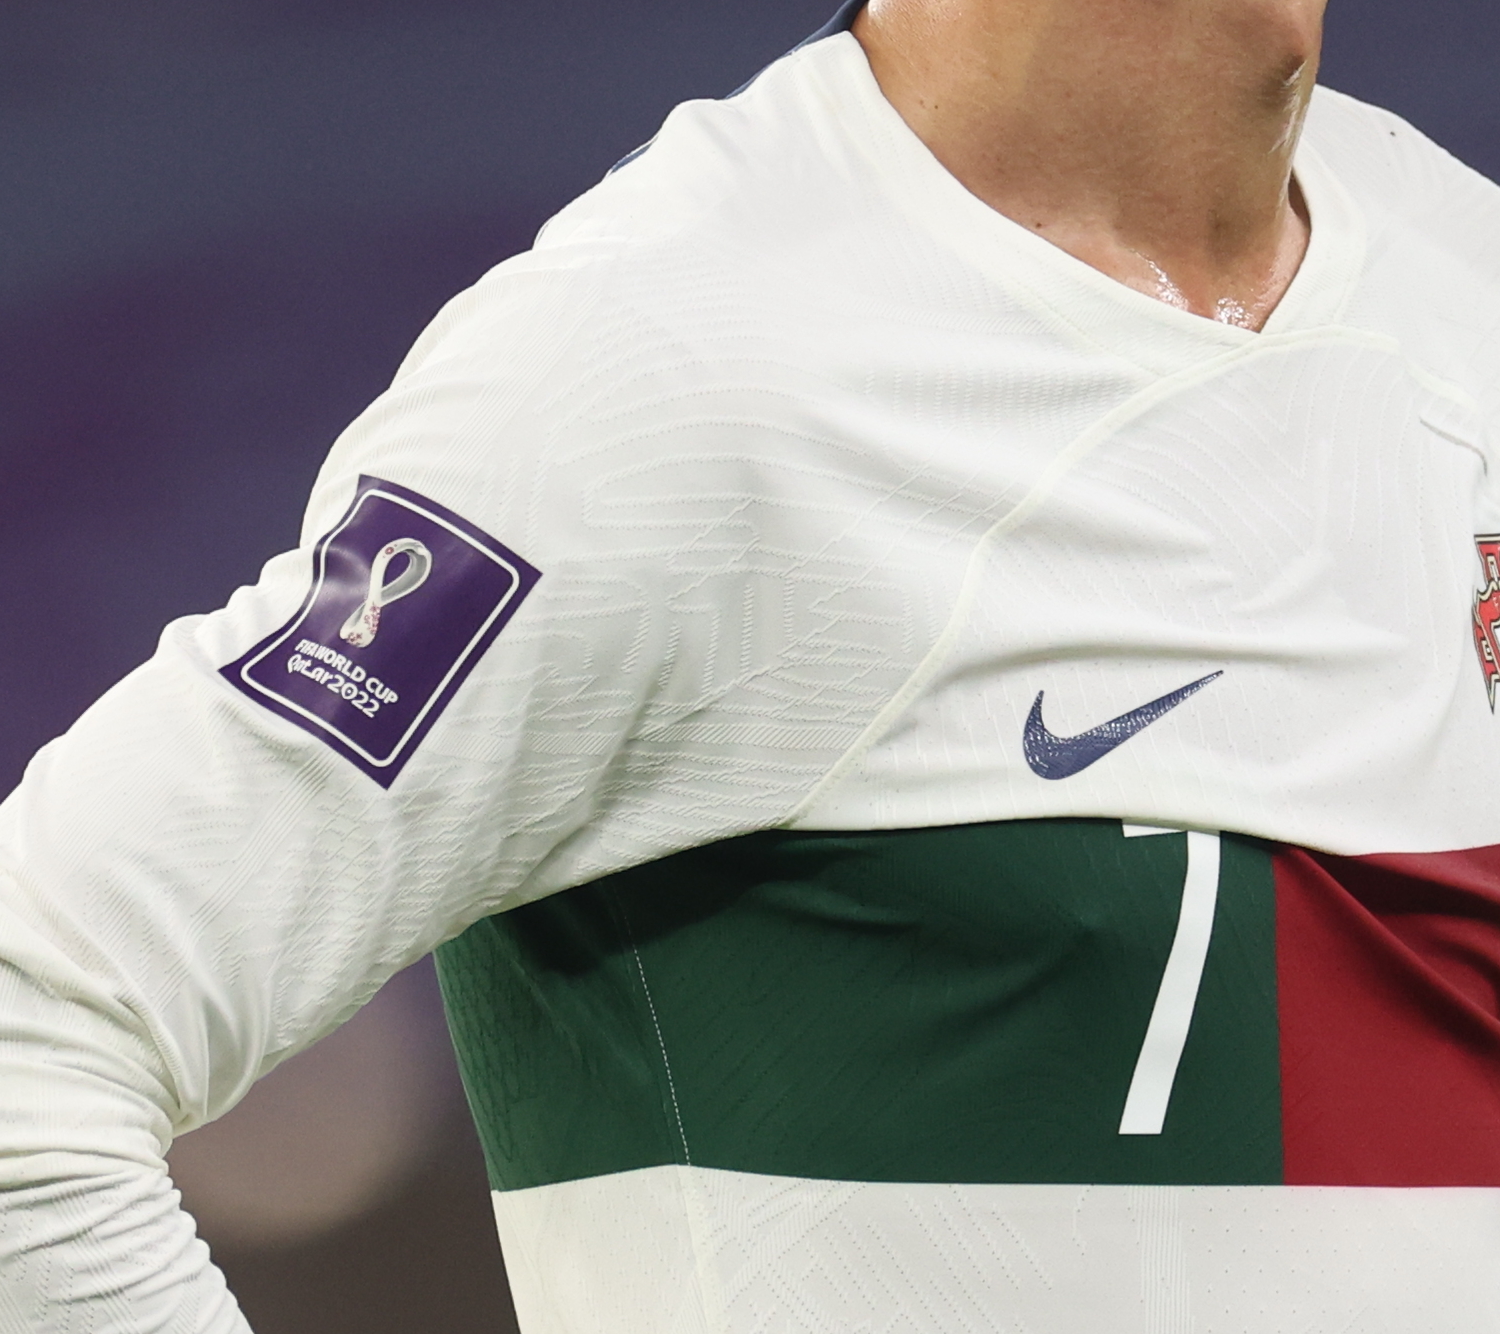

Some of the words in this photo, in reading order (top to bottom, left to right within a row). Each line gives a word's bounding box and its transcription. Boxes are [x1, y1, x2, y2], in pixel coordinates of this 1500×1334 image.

[314, 646, 366, 682] WORLD
[365, 677, 398, 704] CUP
[1118, 818, 1220, 1135] 7
